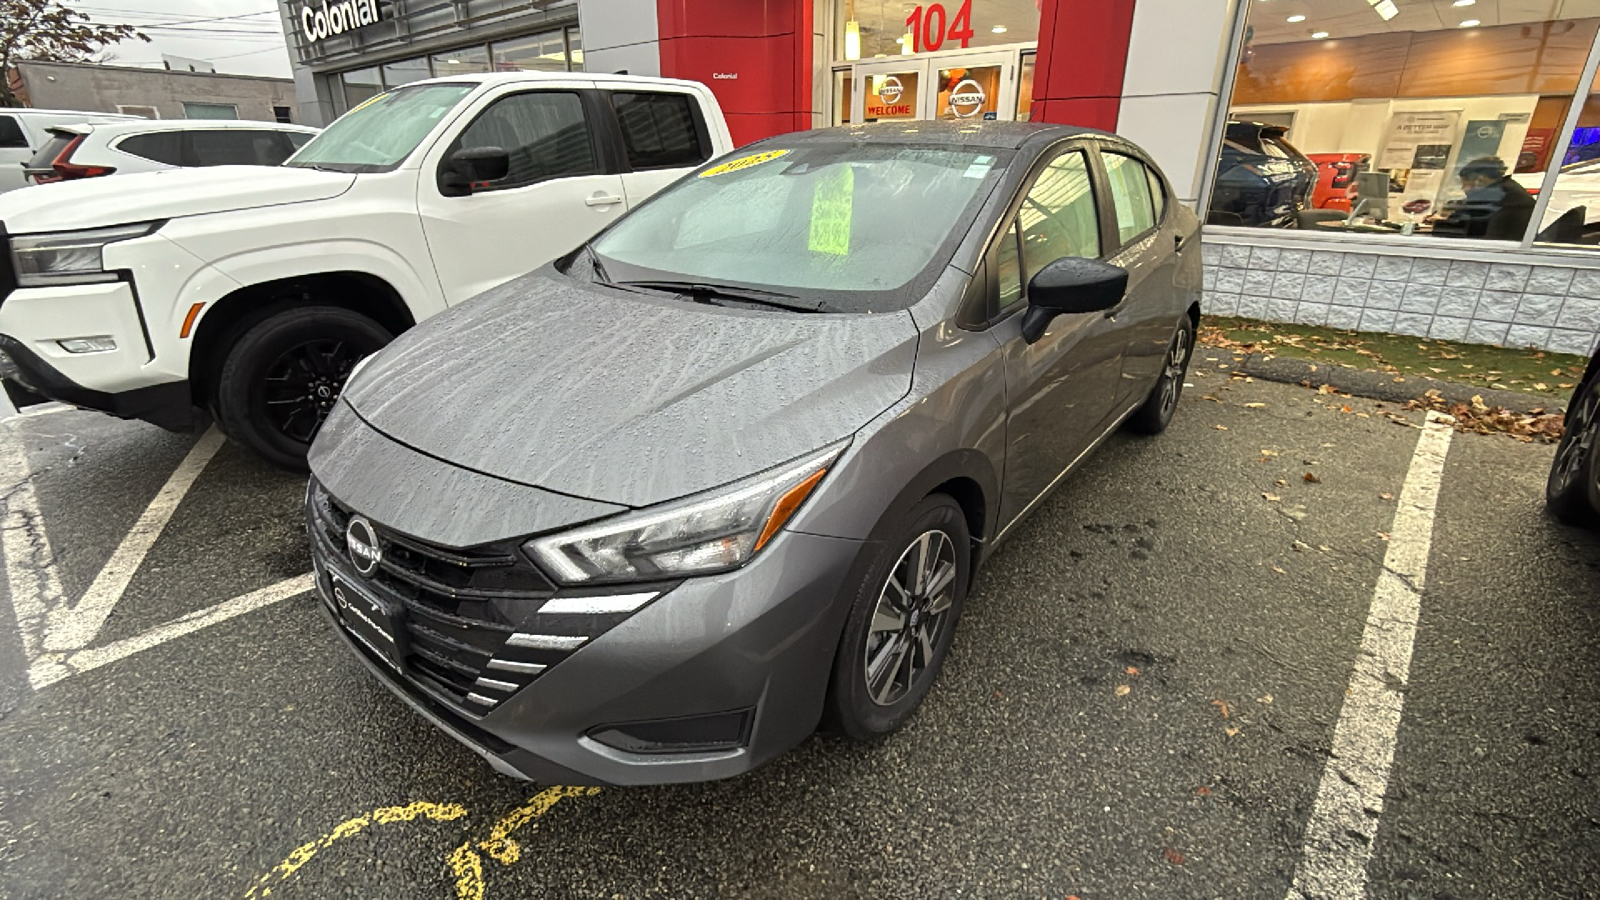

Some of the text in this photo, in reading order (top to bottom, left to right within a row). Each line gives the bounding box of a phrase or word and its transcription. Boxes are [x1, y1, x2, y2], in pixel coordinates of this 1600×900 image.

[302, 0, 379, 42] Colonial
[906, 0, 974, 53] 104
[868, 105, 911, 115] WELCOME
[348, 536, 380, 562] SSAN
